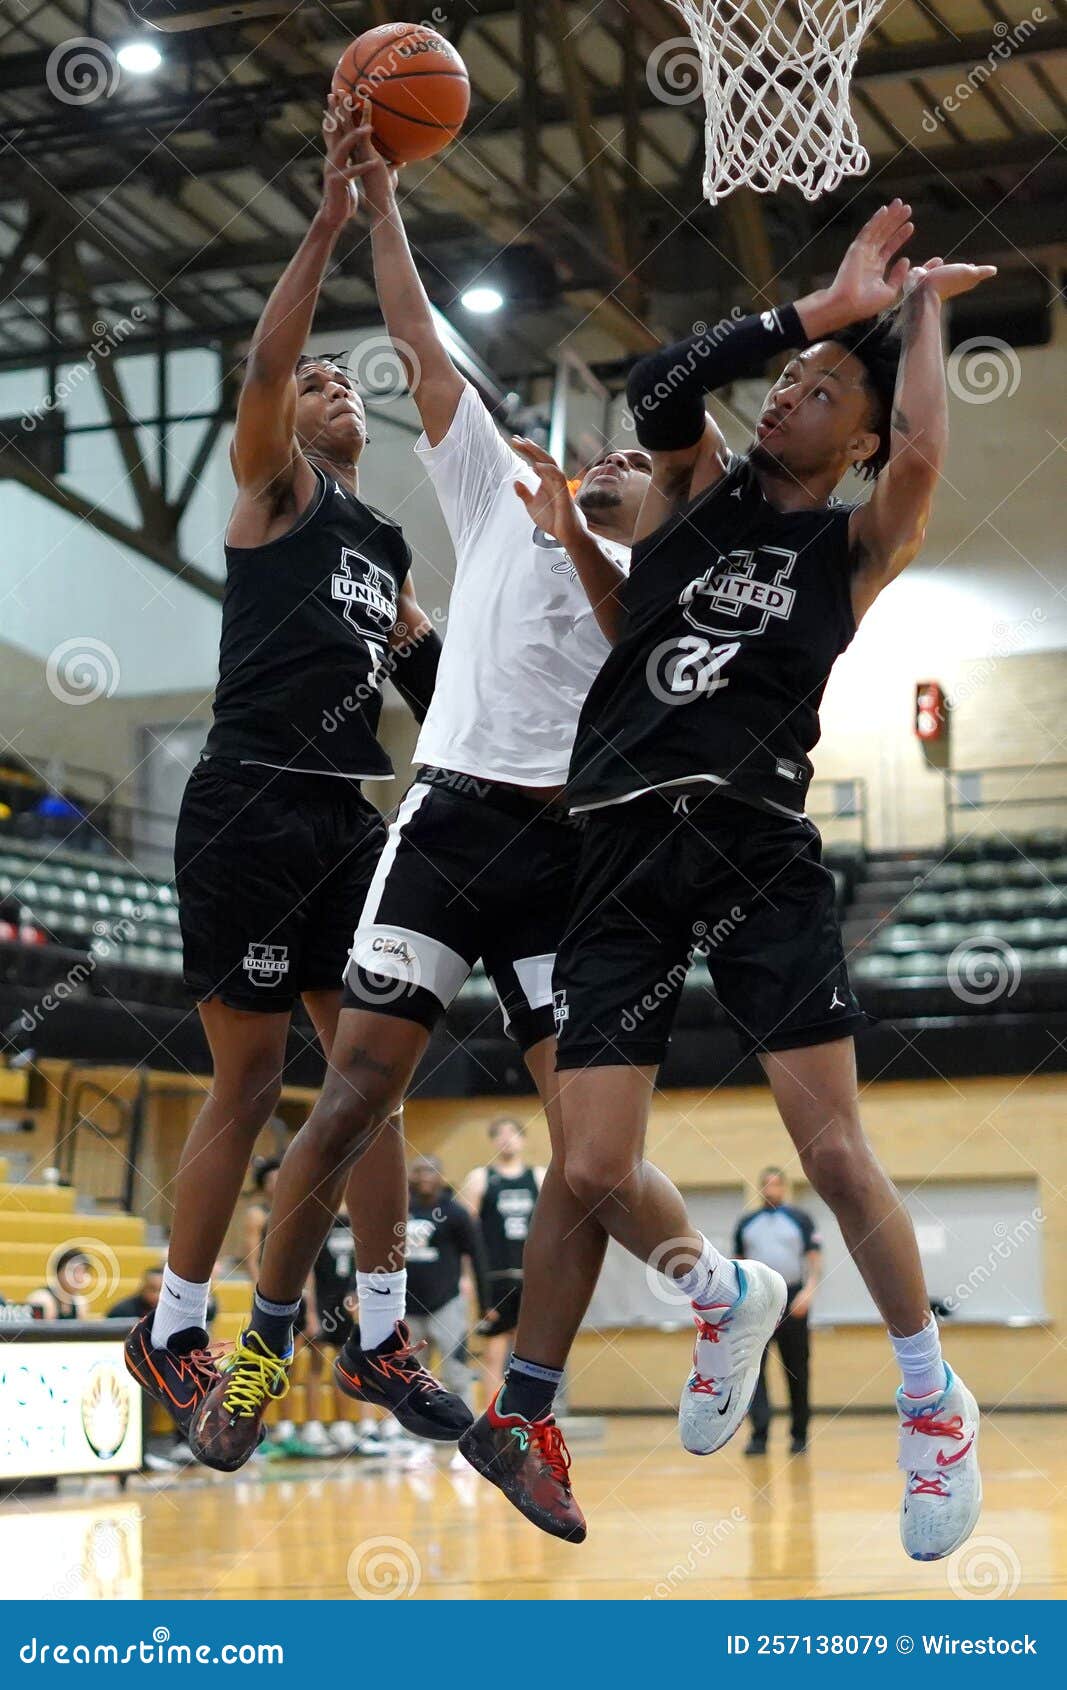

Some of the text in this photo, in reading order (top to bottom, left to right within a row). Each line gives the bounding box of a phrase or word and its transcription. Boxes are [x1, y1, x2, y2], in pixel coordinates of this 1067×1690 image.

[671, 635, 742, 692] 22
[420, 766, 494, 799] NIKE
[247, 960, 286, 970] UNITED
